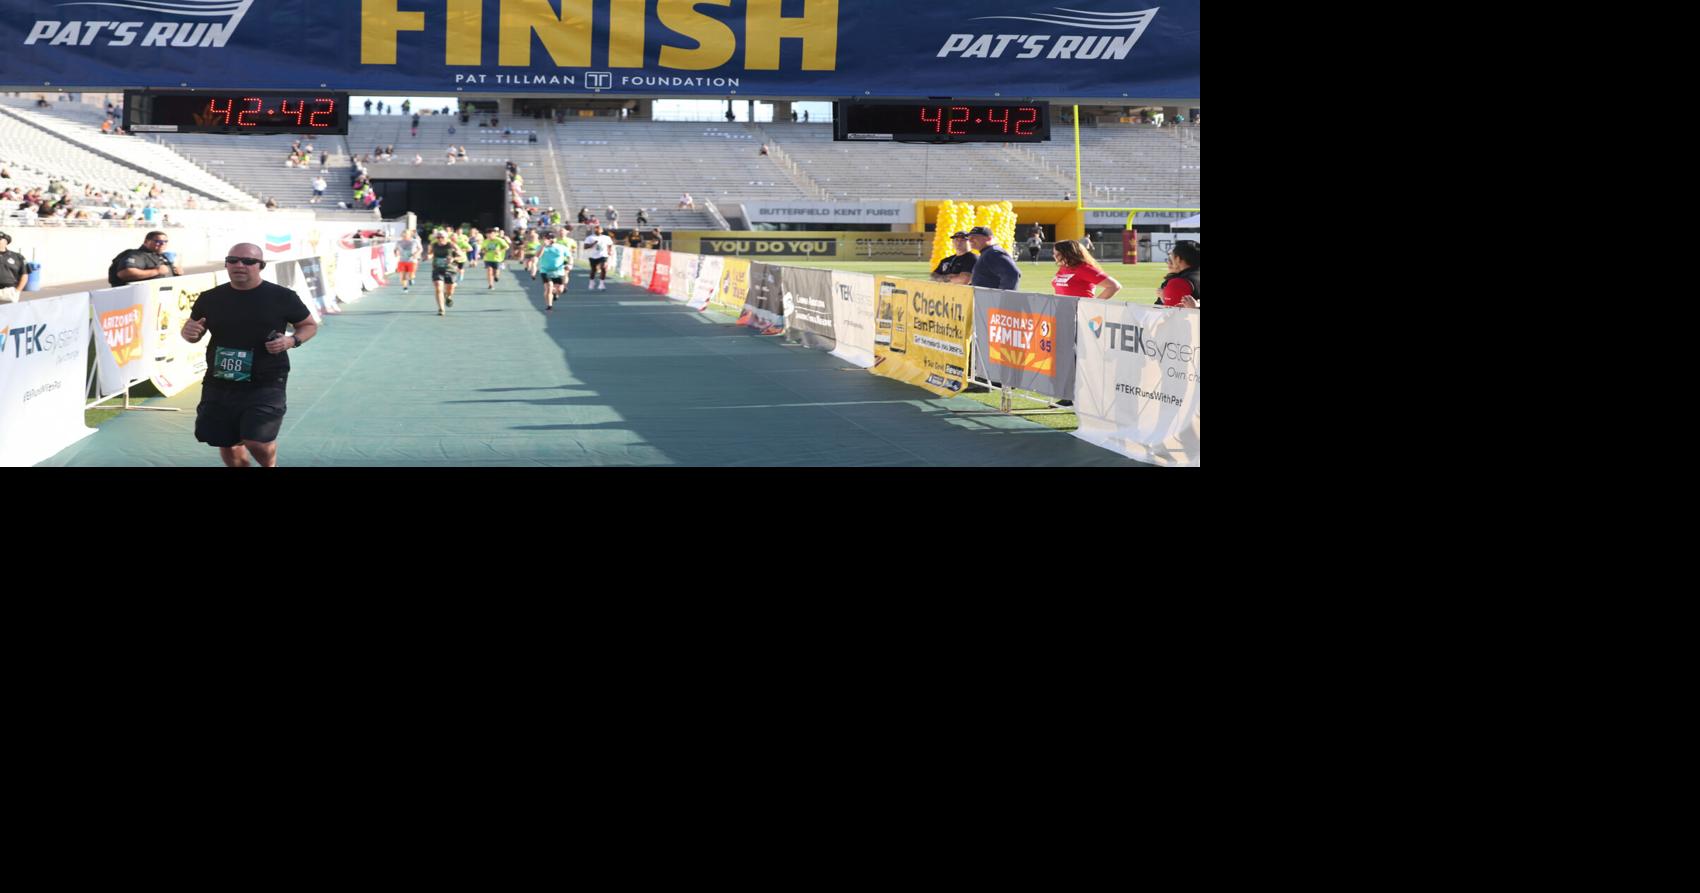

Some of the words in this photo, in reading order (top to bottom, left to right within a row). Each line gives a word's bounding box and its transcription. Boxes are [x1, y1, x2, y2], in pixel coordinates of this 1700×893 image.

[24, 21, 144, 46] PAT'S
[141, 19, 240, 48] RUN
[360, 0, 838, 71] FINISH
[936, 34, 1050, 60] PAT'S
[1047, 34, 1143, 61] RUN
[455, 74, 487, 84] PAT
[495, 75, 576, 86] TILLMAN
[621, 76, 740, 88] FOUNDATION
[759, 208, 830, 216] BUTTERFIELD
[833, 208, 862, 216] KENT
[866, 209, 900, 217] FURST
[711, 240, 750, 253] YOU
[755, 240, 787, 253] DO
[788, 240, 828, 253] YOU
[990, 313, 1034, 331] ARZONA'S
[989, 325, 1034, 350] FAMILY
[1104, 321, 1200, 363] TEKsyste
[220, 357, 243, 372] 468
